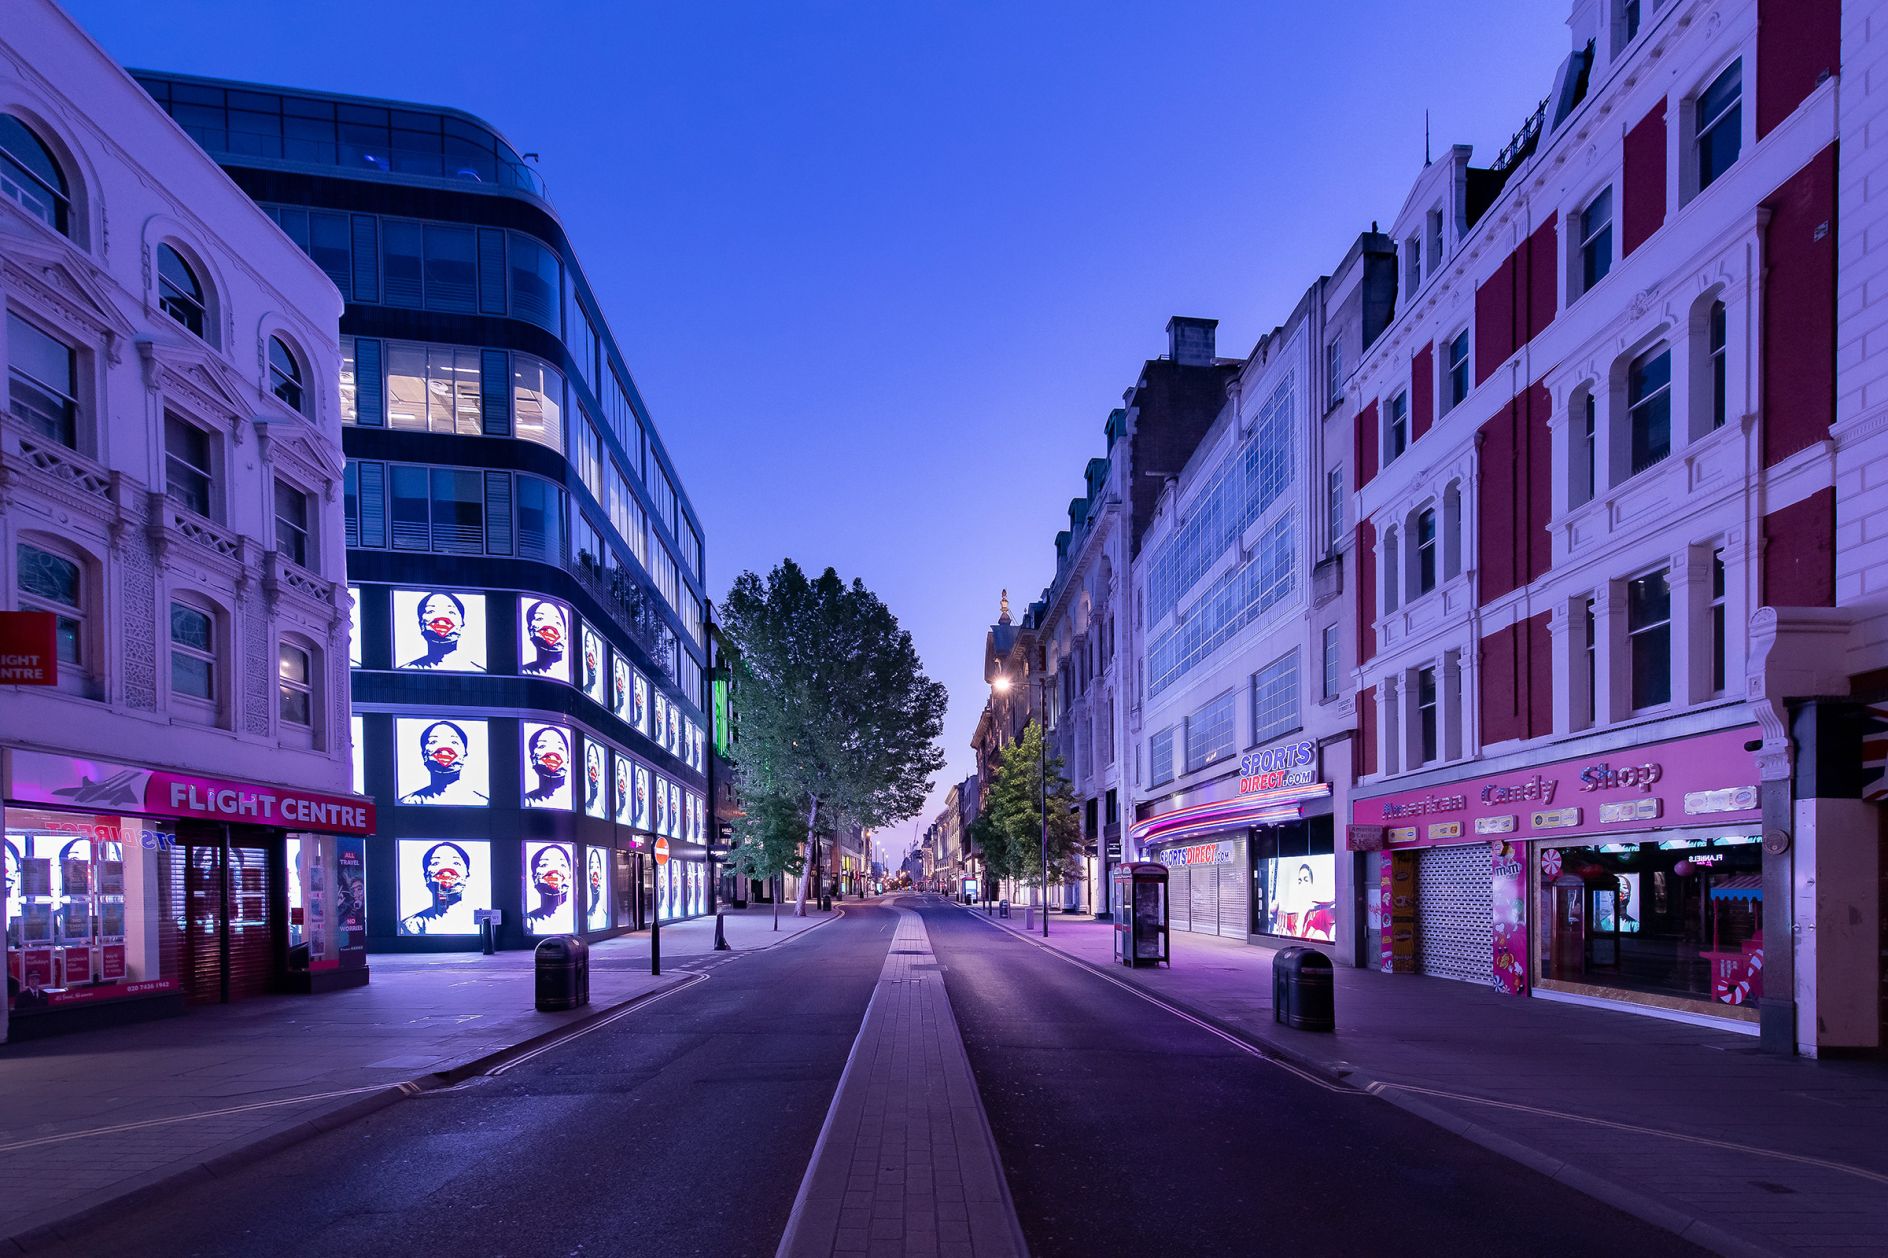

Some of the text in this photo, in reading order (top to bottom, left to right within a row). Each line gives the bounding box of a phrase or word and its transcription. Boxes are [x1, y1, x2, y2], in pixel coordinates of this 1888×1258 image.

[1239, 741, 1312, 777] SPORTS
[170, 782, 366, 828] FLIGHT CENTRE
[1382, 762, 1662, 820] American Candy Shop
